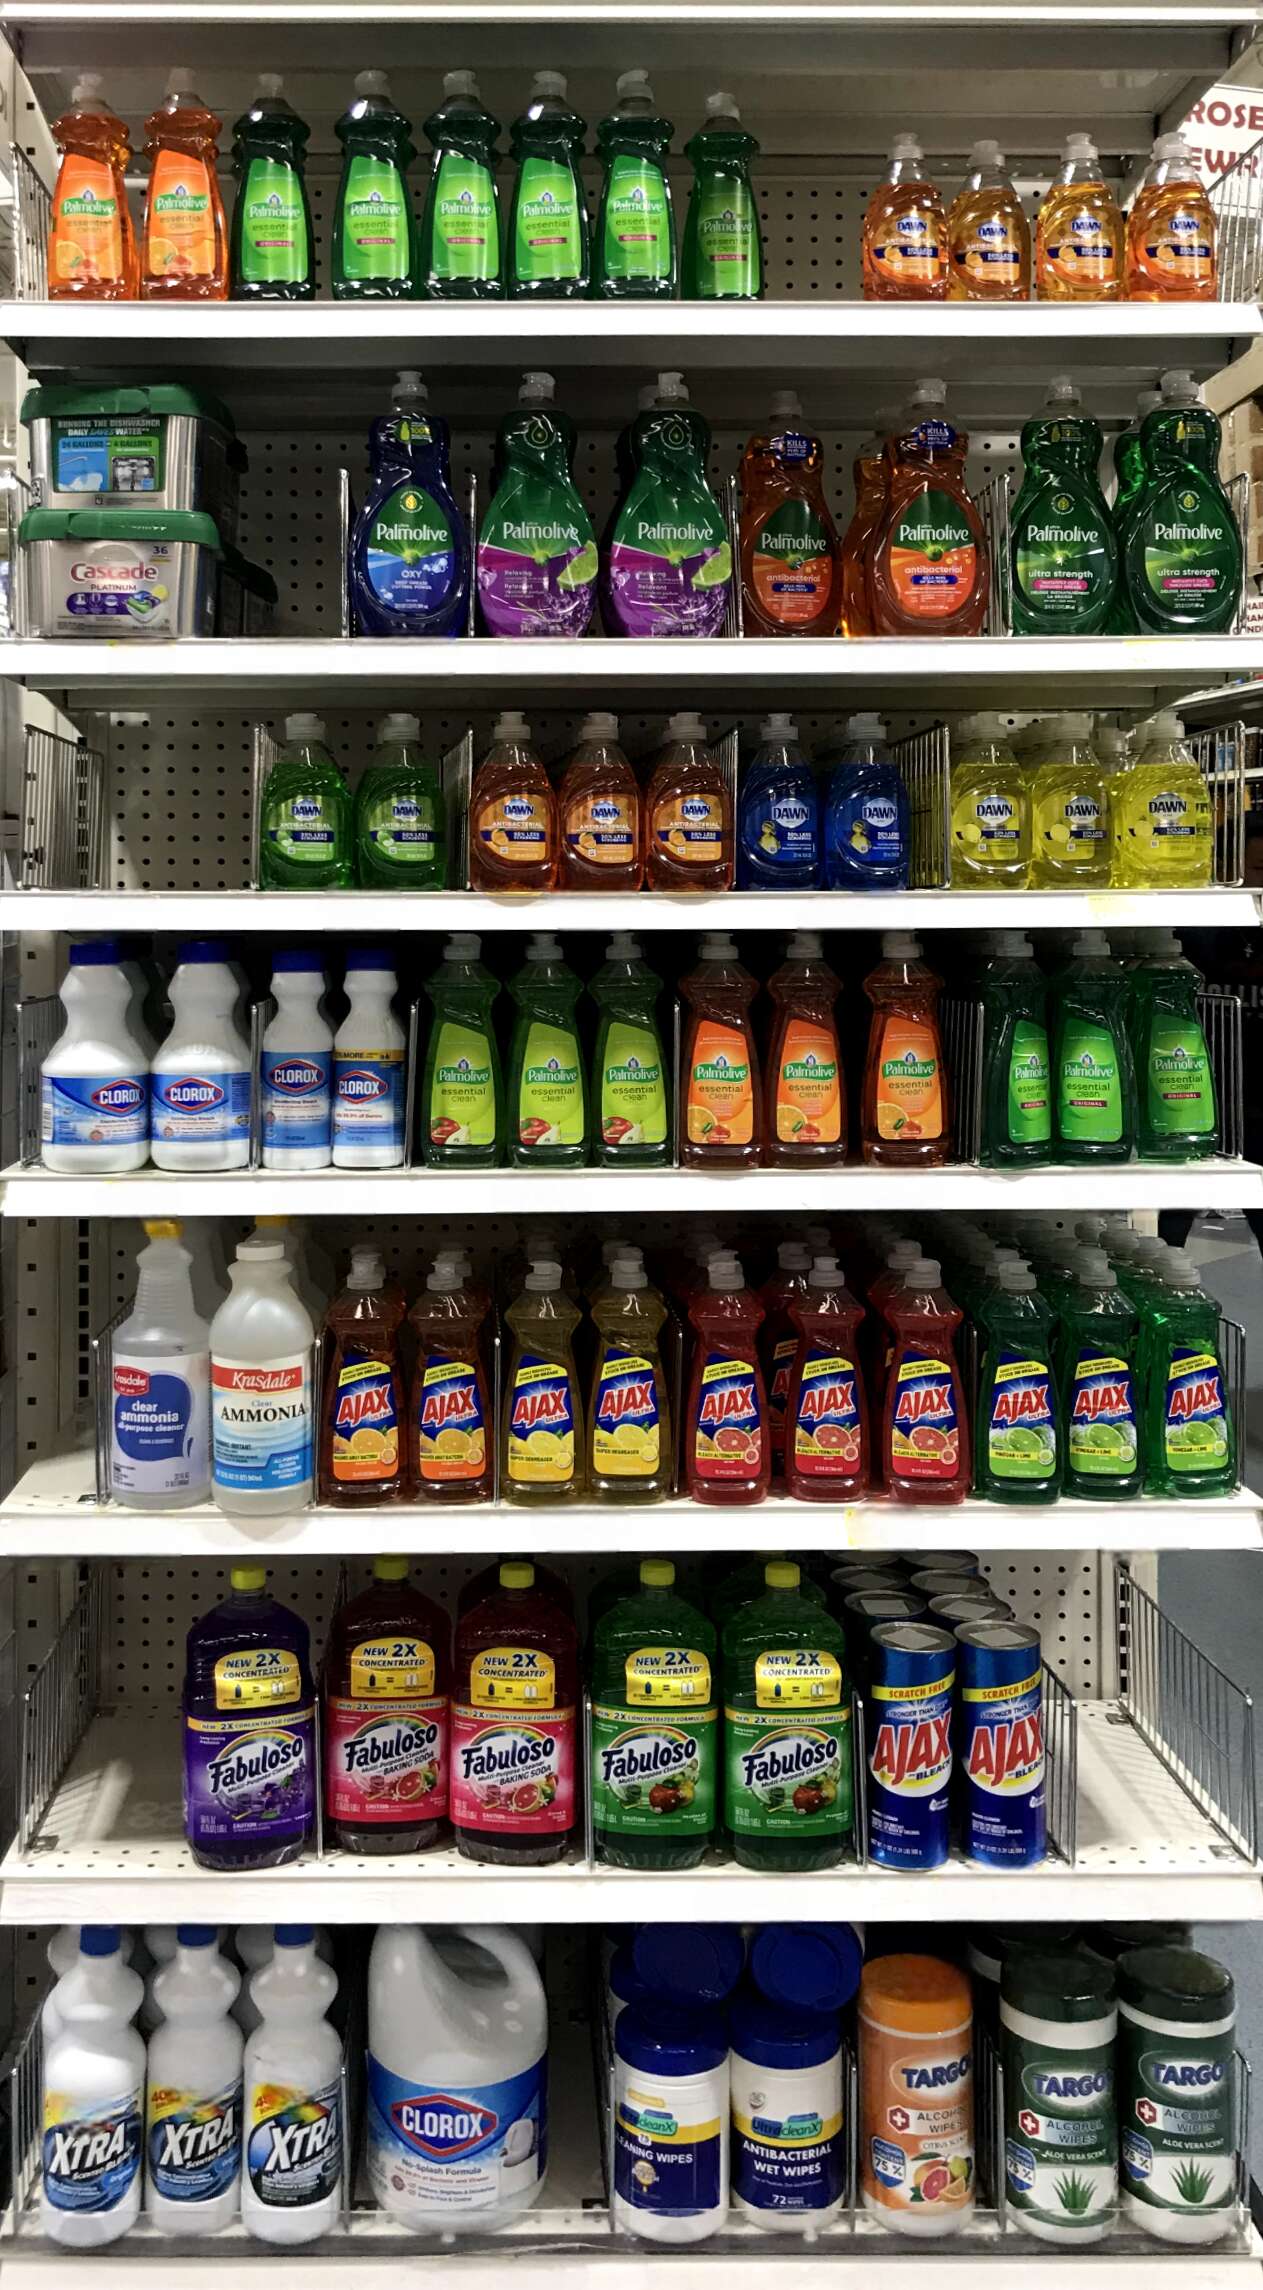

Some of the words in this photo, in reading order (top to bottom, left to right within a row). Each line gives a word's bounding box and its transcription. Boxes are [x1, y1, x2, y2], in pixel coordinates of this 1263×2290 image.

[441, 202, 492, 215] Palmolive
[927, 428, 949, 436] KILLS
[787, 440, 807, 448] KILLS
[376, 522, 449, 542] Palmolive
[503, 521, 580, 541] Palmolive
[638, 522, 715, 541] Palmolive
[899, 524, 970, 543] Palmolive
[1027, 524, 1099, 543] Palmolive
[1154, 523, 1223, 541] Palmolive
[761, 533, 827, 552] Palmolive
[152, 545, 168, 555] 36
[69, 561, 158, 583] Cascade
[400, 569, 422, 579] OXY
[904, 565, 963, 575] antibacterial
[1028, 570, 1052, 579] ultra
[1053, 570, 1094, 580] strength
[1157, 569, 1180, 578] ultra
[1182, 568, 1220, 579] strength
[766, 574, 821, 584] antibacterial
[91, 583, 137, 591] PLATINUM
[291, 805, 323, 817] DAWN
[392, 805, 423, 817] DAWN
[504, 804, 535, 815] DAWN
[591, 806, 621, 818] DAWN
[681, 804, 713, 816] DAWN
[773, 806, 810, 820] DAWN
[862, 806, 898, 820] DAWN
[976, 804, 1014, 817] DAWN
[1065, 804, 1102, 817] DAWN
[1148, 800, 1188, 813] DAWN
[786, 1065, 836, 1078] Palmolive
[885, 1063, 935, 1076] Palmolive
[1064, 1064, 1114, 1078] Palmolive
[1155, 1058, 1205, 1071] Palmolive
[274, 1068, 319, 1084] CLOROX
[439, 1069, 489, 1082] Palmolive
[528, 1069, 577, 1082] Palmolive
[609, 1068, 659, 1081] Palmolive
[697, 1066, 746, 1080] Palmolive
[1158, 1074, 1203, 1084] essential
[338, 1080, 380, 1095] CLOROX
[441, 1087, 486, 1096] essential
[530, 1087, 576, 1095] essential
[612, 1085, 657, 1095] essential
[698, 1084, 744, 1093] essential
[788, 1083, 833, 1092] essential
[887, 1079, 933, 1090] essential
[899, 1087, 924, 1096] clean
[1066, 1081, 1111, 1091] essential
[99, 1089, 140, 1106] CLOROX
[170, 1087, 215, 1102] CLOROX
[452, 1095, 477, 1103] clean
[622, 1093, 648, 1101] clean
[708, 1092, 734, 1100] clean
[798, 1090, 824, 1099] clean
[232, 1370, 295, 1391] Krasdale
[132, 1400, 158, 1412] clear
[337, 1385, 390, 1427] AJAX
[422, 1385, 475, 1427] AJAX
[598, 1381, 653, 1421] AJAX
[699, 1384, 754, 1424] AJAX
[799, 1381, 854, 1421] AJAX
[896, 1384, 952, 1424] AJAX
[993, 1385, 1048, 1424] AJAX
[1073, 1381, 1129, 1421] AJAX
[1168, 1378, 1218, 1420] AJAX
[221, 1404, 307, 1423] AMMONIA
[512, 1388, 567, 1428] AJAX
[121, 1410, 179, 1424] ammonia
[155, 1422, 185, 1433] cleaner
[363, 1647, 388, 1657] NEW
[392, 1643, 418, 1658] 2X
[225, 1658, 252, 1669] NEW
[255, 1652, 281, 1667] 2X
[359, 1658, 426, 1667] CONCENTRATED
[483, 1657, 508, 1667] NEW
[512, 1653, 538, 1668] 2X
[635, 1656, 661, 1666] NEW
[664, 1651, 690, 1666] 2X
[766, 1656, 792, 1666] NEW
[795, 1652, 821, 1667] 2X
[223, 1667, 290, 1680] CONCENTRATED
[478, 1668, 547, 1678] CONCENTRATED
[633, 1666, 700, 1676] CONCENTRATED
[763, 1667, 831, 1676] CONCENTRATED
[888, 1686, 927, 1699] SCRATCH
[928, 1681, 946, 1695] FREE
[982, 1686, 1018, 1700] SCRATCH
[886, 1708, 918, 1719] STRONGER
[919, 1706, 933, 1716] THAN
[1014, 1705, 1028, 1715] THAN
[221, 1721, 234, 1731] 2X
[344, 1723, 438, 1772] Fabuloso
[873, 1708, 951, 1786] AJAX
[970, 1706, 1042, 1787] AJAX
[384, 1758, 413, 1776] BAKING
[413, 1752, 435, 1767] SODA
[462, 1737, 556, 1778] Fabuloso
[601, 1737, 697, 1782] Fabuloso
[742, 1737, 838, 1787] Fabuloso
[208, 1736, 304, 1794] Fabuloso
[499, 1773, 530, 1787] BAKING
[530, 1764, 552, 1779] SODA
[402, 2104, 483, 2139] CLOROX
[159, 2106, 235, 2167] XTRA
[265, 2108, 337, 2172] XTRA
[1059, 2133, 1098, 2145] WIPES
[1162, 2137, 1183, 2147] ALOE
[1184, 2139, 1205, 2149] VERA
[1205, 2137, 1226, 2149] SCENT
[49, 2122, 125, 2176] XTRA
[743, 2140, 832, 2161] ANTIBACTERIAL
[1044, 2149, 1065, 2159] ALOE
[1066, 2151, 1086, 2161] VERA
[1087, 2148, 1107, 2160] SCENT
[656, 2152, 694, 2164] WIPES
[875, 2157, 889, 2171] 75
[402, 2158, 444, 2176] No-Splash
[445, 2167, 482, 2177] Formula
[753, 2159, 780, 2176] WET
[782, 2162, 822, 2177] WIPES
[772, 2194, 787, 2205] 72
